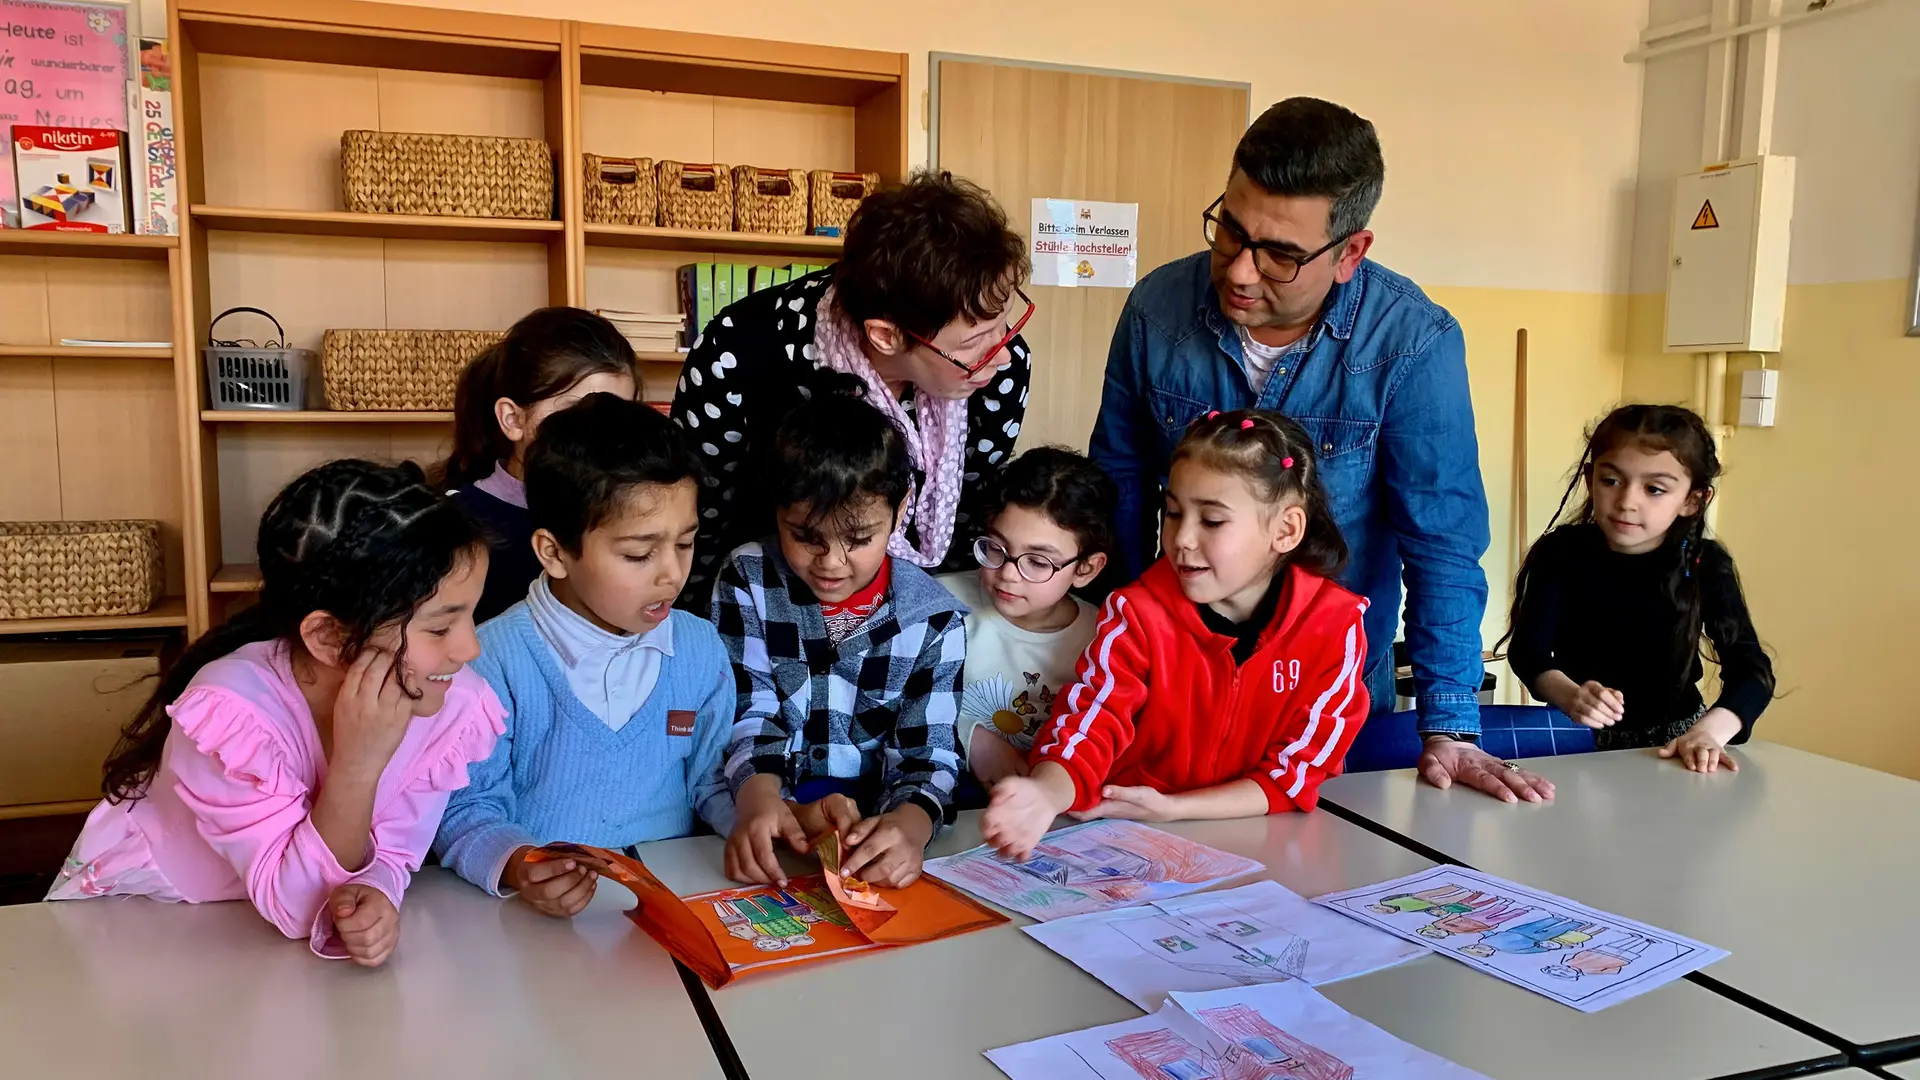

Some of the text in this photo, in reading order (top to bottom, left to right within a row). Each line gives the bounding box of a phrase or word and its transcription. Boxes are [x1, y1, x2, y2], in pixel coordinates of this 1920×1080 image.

[0, 22, 84, 46] Heute ist
[31, 58, 115, 73] wunderbarer
[56, 87, 84, 100] um
[145, 100, 162, 119] 25
[42, 131, 92, 145] nikitin
[150, 192, 166, 210] XL
[1038, 223, 1129, 236] Bitte beim Verlassen
[1035, 241, 1132, 255] Stühle hochstellen!
[1273, 659, 1300, 693] 69
